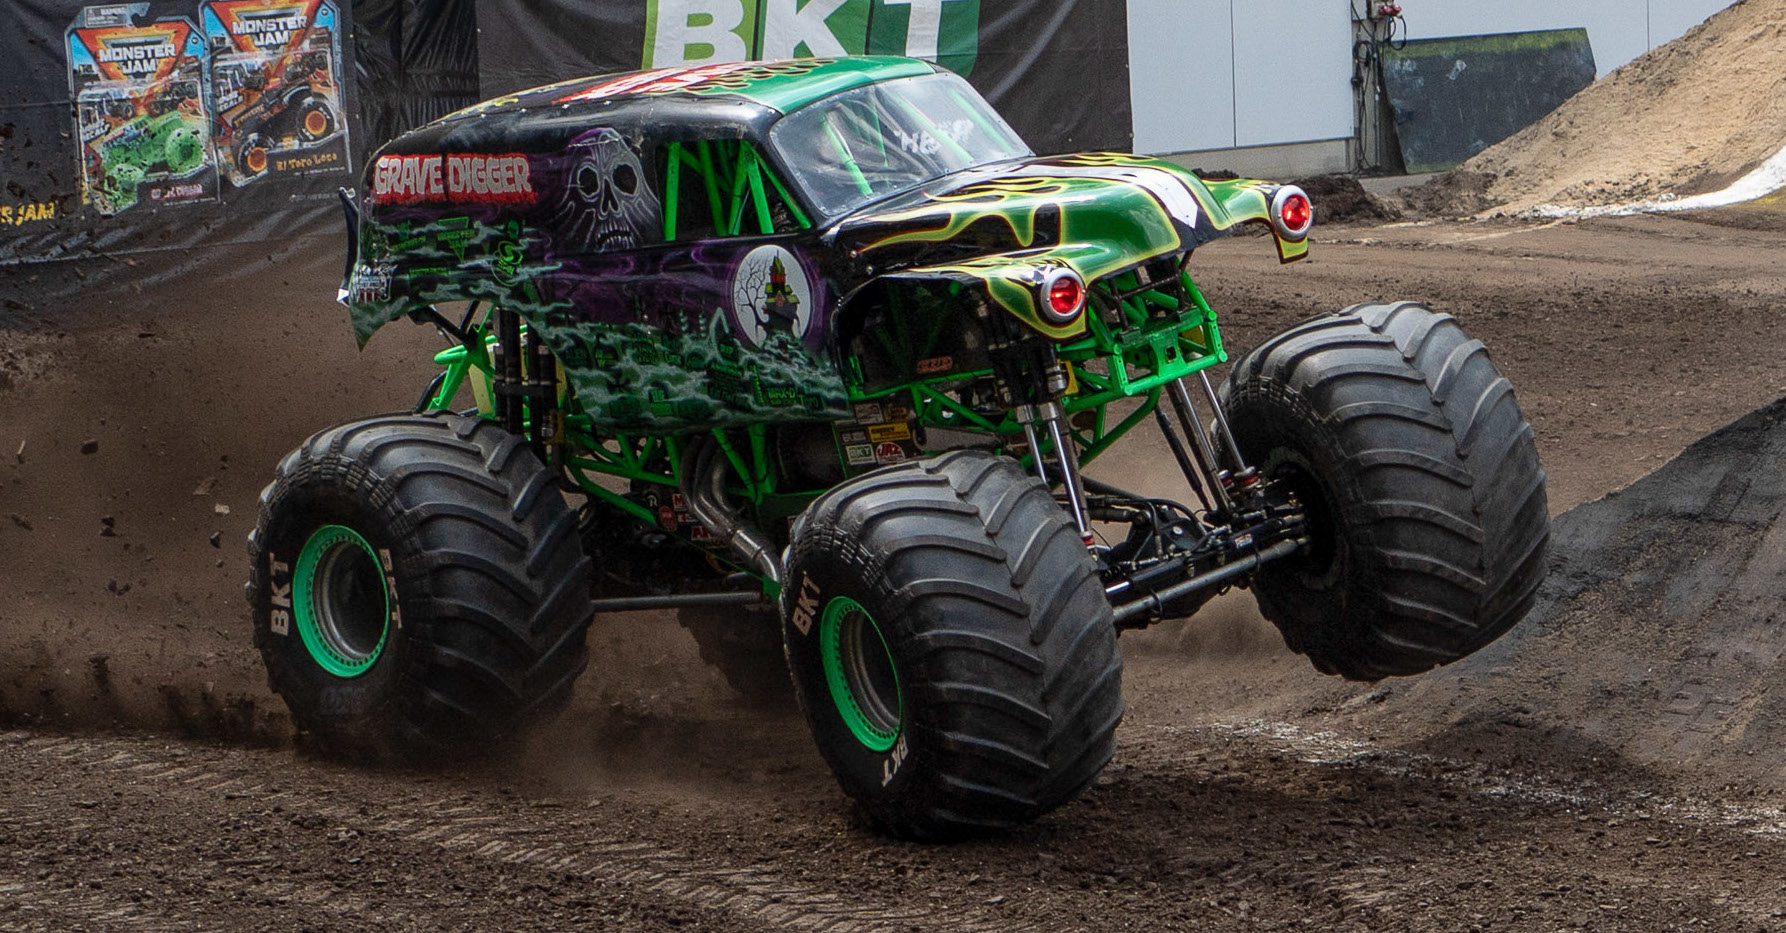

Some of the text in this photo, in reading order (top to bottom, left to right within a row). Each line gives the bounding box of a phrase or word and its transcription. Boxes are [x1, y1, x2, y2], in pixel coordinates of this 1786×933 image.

[232, 16, 307, 35] MONSTER
[254, 31, 289, 46] JAM
[652, 0, 972, 69] BKT
[98, 43, 176, 62] MONSTER
[122, 59, 157, 74] JAM
[288, 157, 312, 169] Toro
[374, 156, 532, 195] GRAVE DIGGER
[269, 551, 290, 637] BKT
[378, 548, 403, 629] BKT
[792, 572, 821, 637] BKT
[881, 732, 909, 788] BKT
